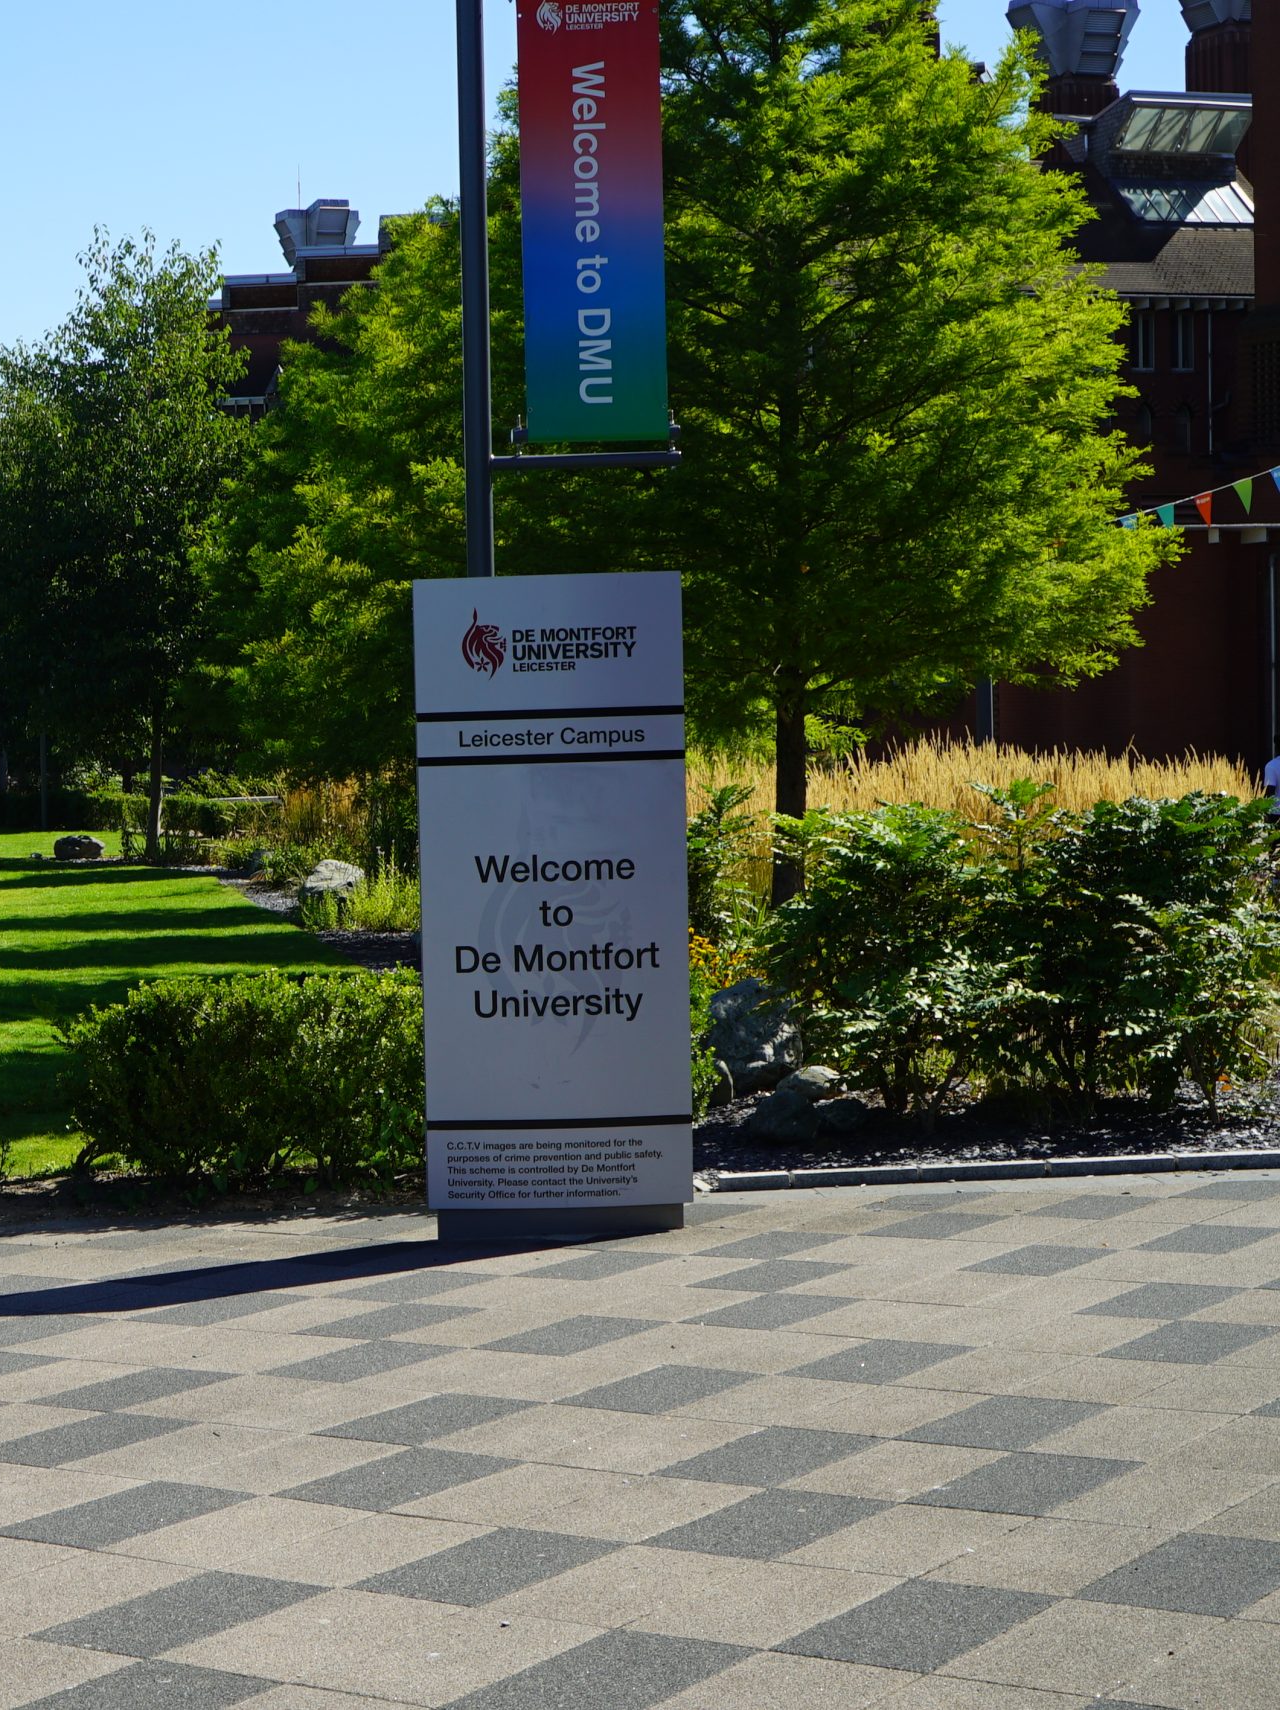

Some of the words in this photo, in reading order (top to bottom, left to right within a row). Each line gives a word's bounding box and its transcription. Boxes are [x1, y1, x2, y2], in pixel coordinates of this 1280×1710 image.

[566, 5, 579, 13] DE
[582, 2, 639, 12] MONTFORT
[566, 11, 639, 23] UNIVERSITY
[571, 61, 606, 243] Welcome
[576, 254, 608, 294] to
[577, 308, 613, 404] DMU
[512, 629, 535, 643] DE
[541, 626, 636, 642] MONTFORT
[513, 641, 636, 661] UNIVERSITY
[513, 661, 575, 672] LEICESTER
[459, 729, 553, 748] Leicester
[560, 727, 645, 747] Campus
[474, 854, 635, 883] Welcome
[539, 901, 573, 926] to
[456, 946, 501, 973] De
[514, 942, 660, 972] Montfort
[474, 987, 643, 1021] University
[447, 1142, 480, 1150] C.C.T.V
[483, 1141, 516, 1151] images
[519, 1142, 533, 1150] are
[536, 1140, 561, 1151] being
[565, 1139, 611, 1149] monitored
[613, 1139, 626, 1147] for
[629, 1138, 643, 1147] the
[447, 1154, 489, 1164] purposes
[493, 1153, 502, 1162] of
[505, 1153, 530, 1162] crime
[533, 1153, 581, 1163] prevention
[585, 1152, 601, 1161] and
[604, 1151, 632, 1161] public
[635, 1150, 663, 1160] safety.
[448, 1166, 466, 1174] This
[469, 1166, 505, 1174] scheme
[508, 1166, 515, 1174] is
[518, 1164, 564, 1174] controlled
[568, 1164, 578, 1175] by
[582, 1164, 594, 1172] De
[597, 1163, 635, 1172] Montfort
[448, 1178, 494, 1188] University.
[498, 1178, 528, 1186] Please
[531, 1177, 566, 1186] contact
[569, 1177, 583, 1185] the
[586, 1175, 637, 1187] University's
[448, 1190, 485, 1200] Security
[488, 1190, 515, 1199] Office
[518, 1190, 530, 1198] for
[533, 1189, 563, 1198] further
[567, 1188, 620, 1198] information.
